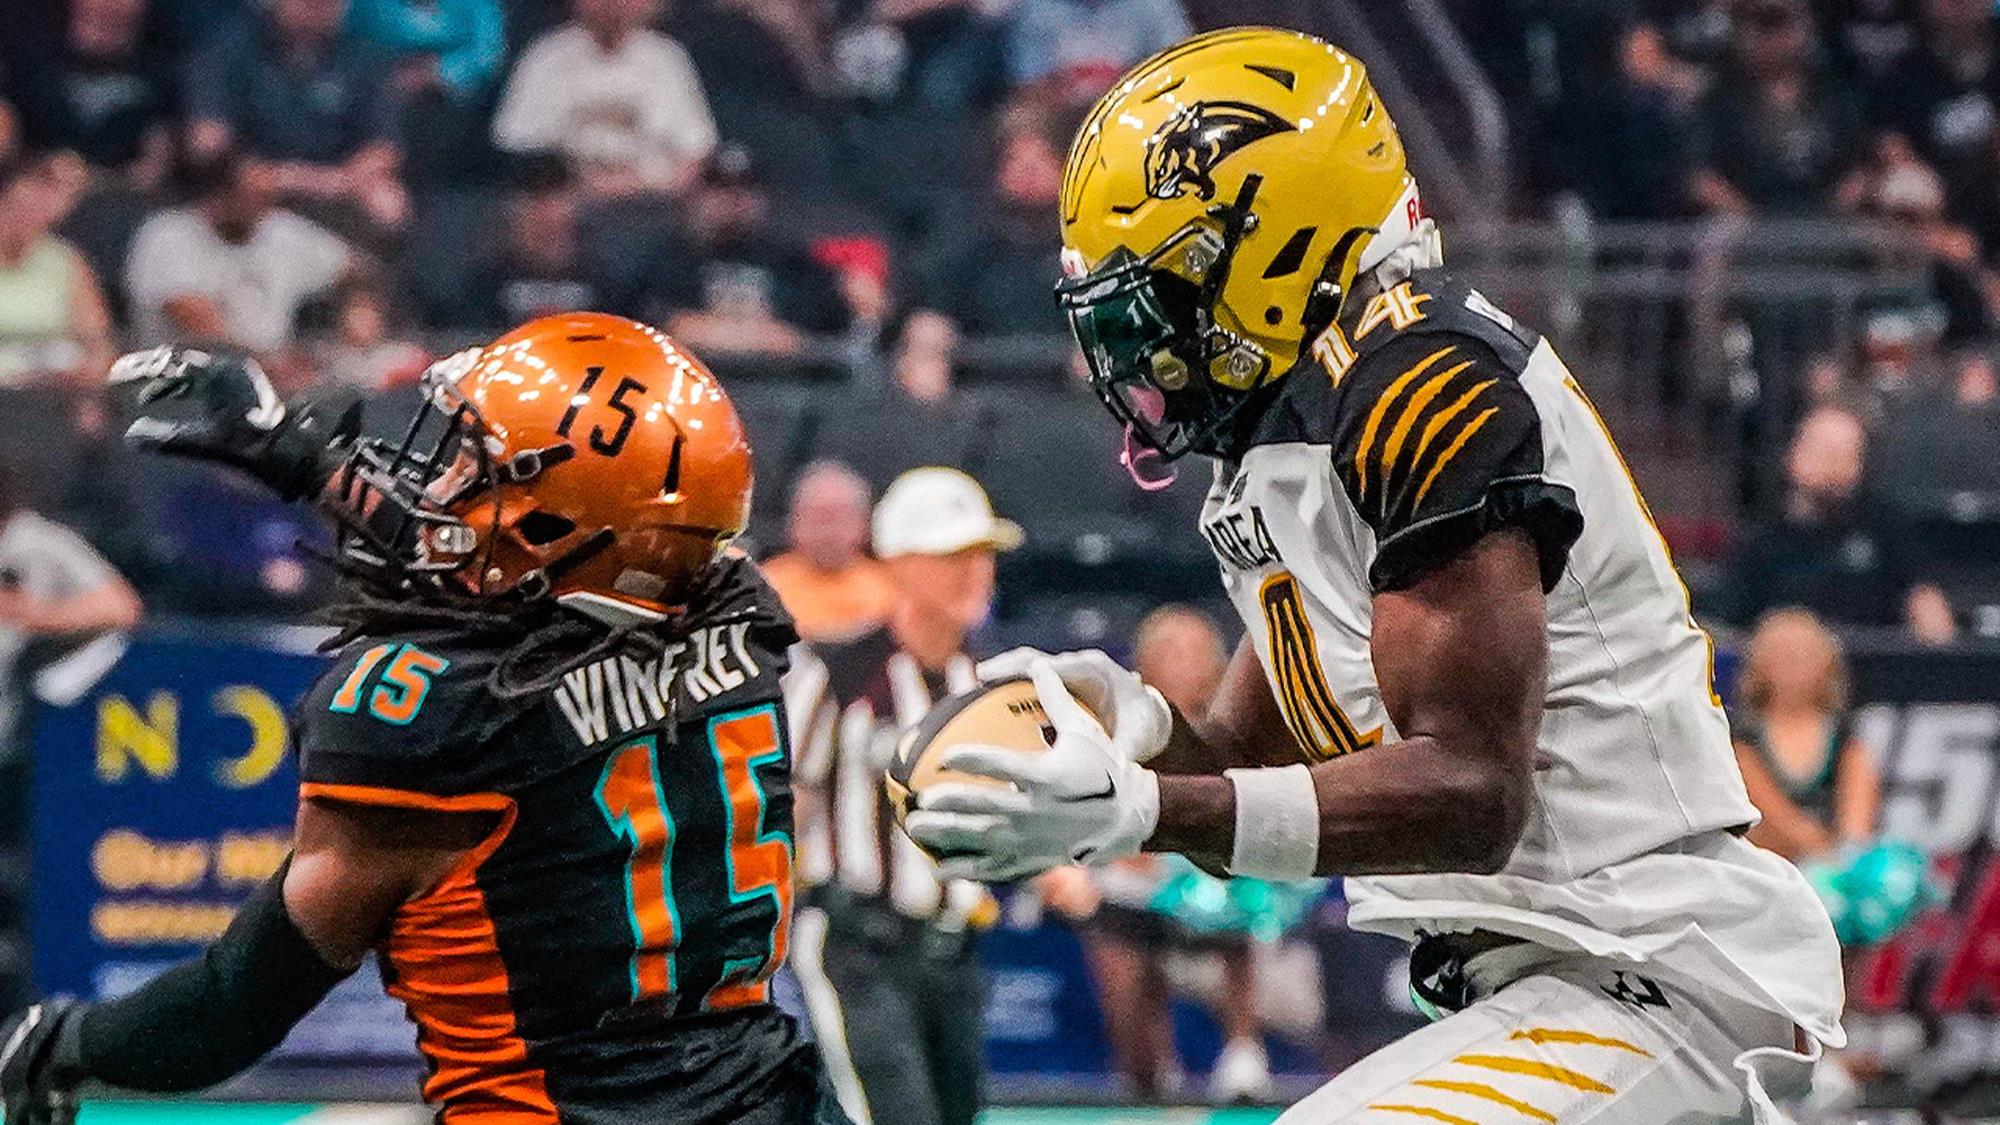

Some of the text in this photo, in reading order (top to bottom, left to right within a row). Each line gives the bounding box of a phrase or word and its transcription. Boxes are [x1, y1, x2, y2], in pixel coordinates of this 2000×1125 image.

[1311, 281, 1433, 388] 14
[555, 366, 648, 457] 15
[329, 643, 450, 726] 15
[553, 621, 761, 747] WINFREY
[593, 703, 794, 1012] 15
